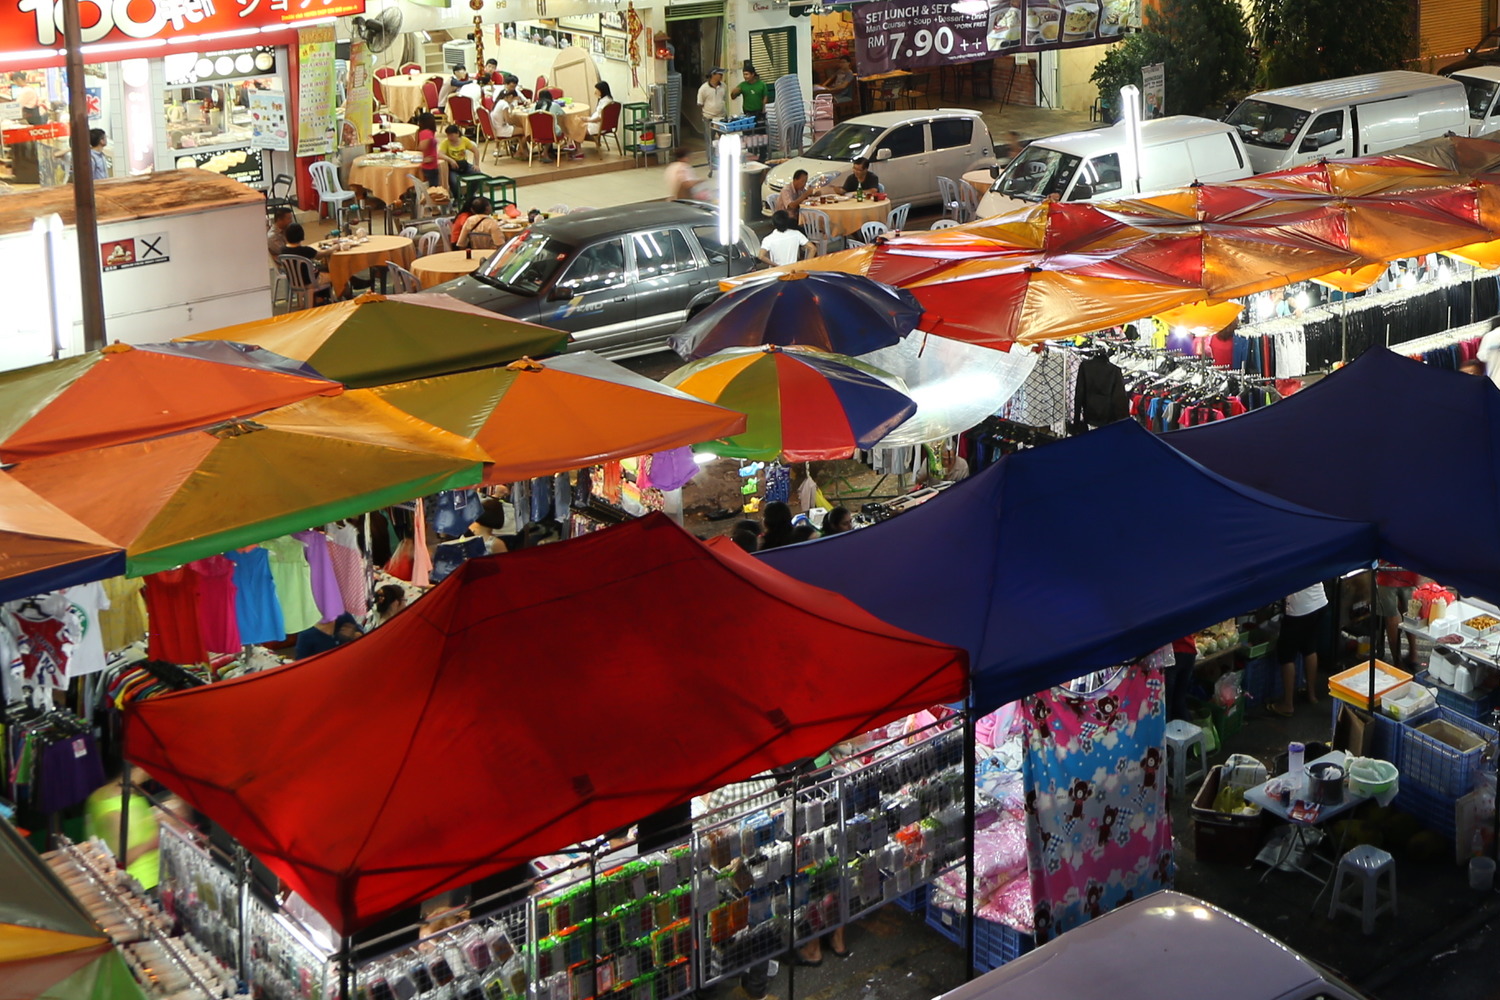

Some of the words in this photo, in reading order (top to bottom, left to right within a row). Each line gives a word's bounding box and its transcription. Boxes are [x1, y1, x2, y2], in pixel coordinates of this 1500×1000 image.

[866, 11, 883, 24] SET
[885, 6, 919, 20] LUNCH
[921, 4, 929, 15] &
[931, 3, 949, 14] SET
[866, 24, 880, 33] Main
[883, 21, 906, 31] Course
[913, 18, 932, 27] Soup
[973, 21, 987, 29] FREE
[868, 35, 885, 48] RM
[889, 26, 954, 60] 7.90
